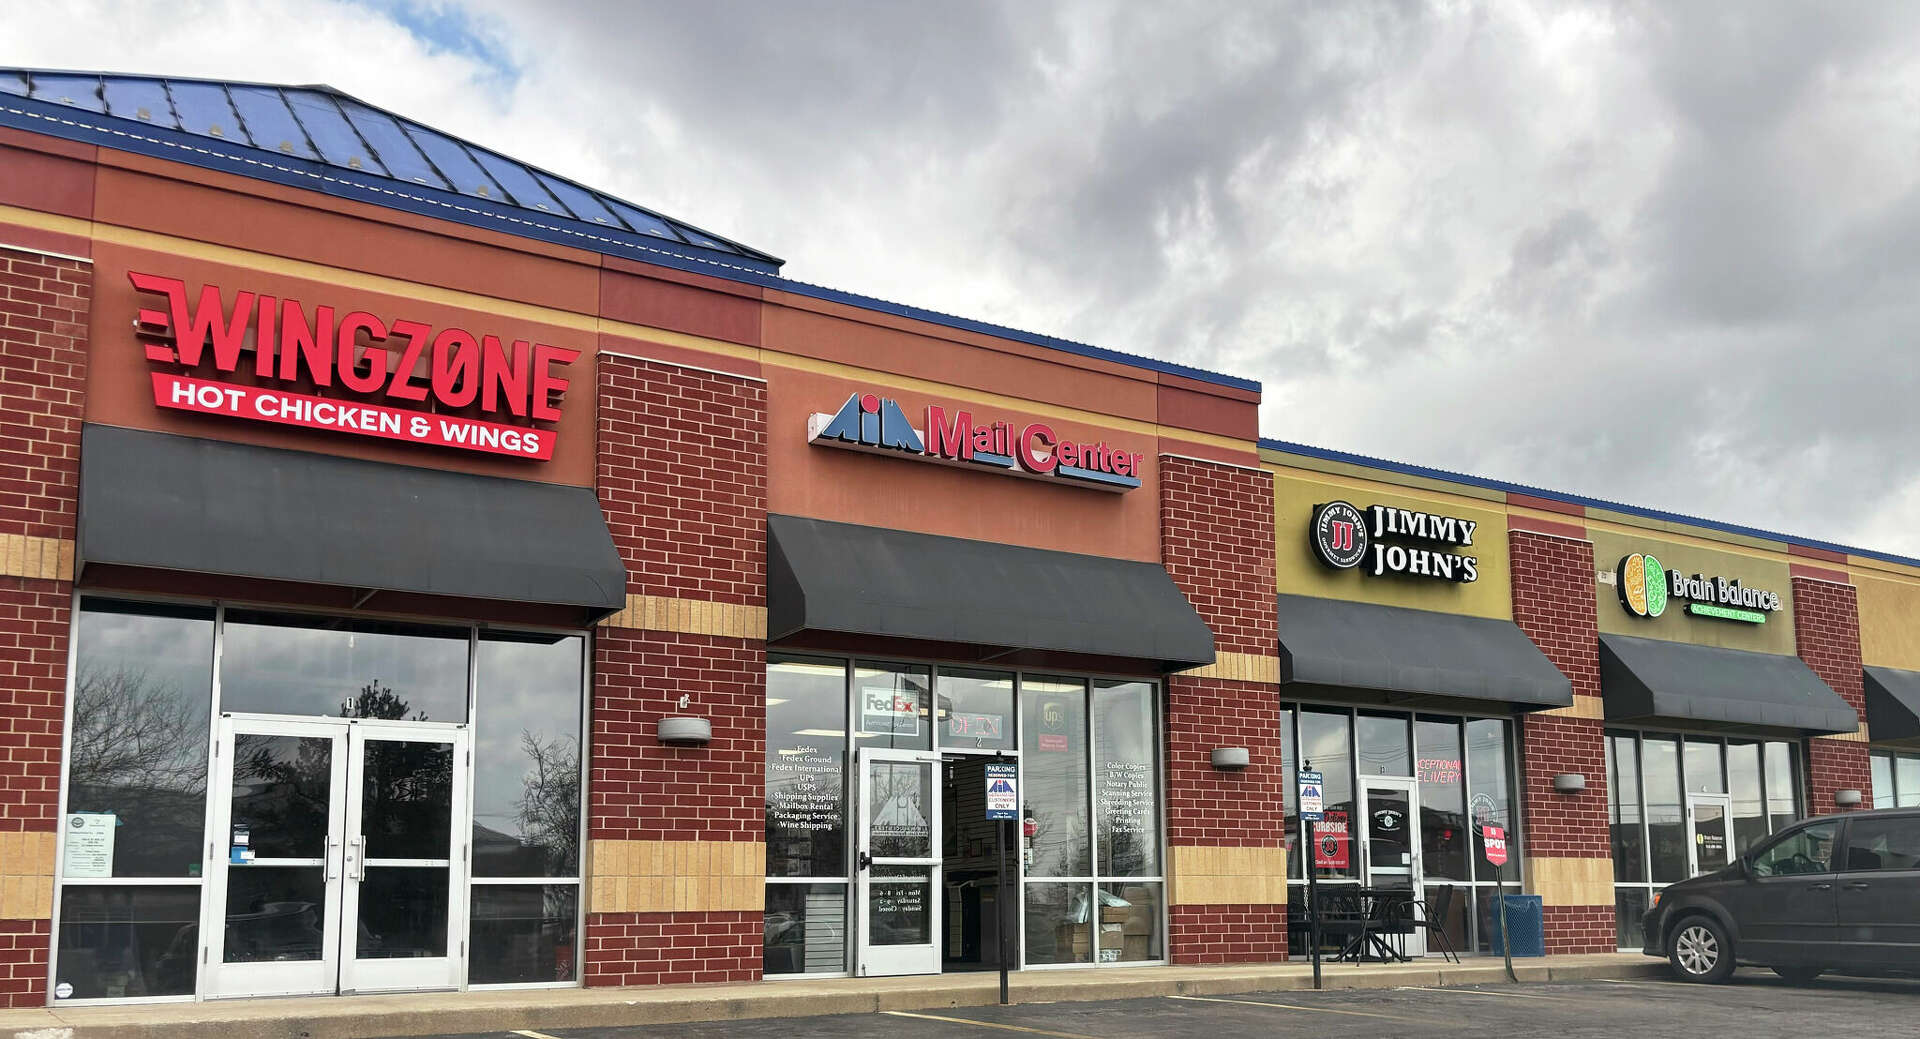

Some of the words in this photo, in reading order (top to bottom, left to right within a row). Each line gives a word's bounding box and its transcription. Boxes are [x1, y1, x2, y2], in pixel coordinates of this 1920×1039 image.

[171, 381, 246, 411] HOT
[254, 394, 402, 435] CHICKEN
[409, 416, 431, 438] &
[440, 420, 540, 453] WINGS
[927, 405, 1014, 461] Mail
[1019, 423, 1144, 478] Center
[1321, 507, 1340, 533] JIMMY
[1373, 506, 1476, 545] JIMMY
[1332, 520, 1353, 550] JJ
[1374, 543, 1478, 581] JOHN'S
[1673, 570, 1714, 601] Brain
[1717, 576, 1779, 610] Balance
[866, 694, 913, 712] FedEx
[794, 764, 842, 773] International
[1106, 781, 1127, 789] Notary
[1417, 771, 1462, 784] ELIVERY
[797, 783, 816, 791] USPS
[774, 792, 807, 801] Shipping
[808, 793, 838, 802] Supplies
[774, 811, 811, 820] Packaging
[812, 812, 838, 820] Service
[800, 821, 833, 831] Shipping
[1484, 838, 1505, 849] SPOT
